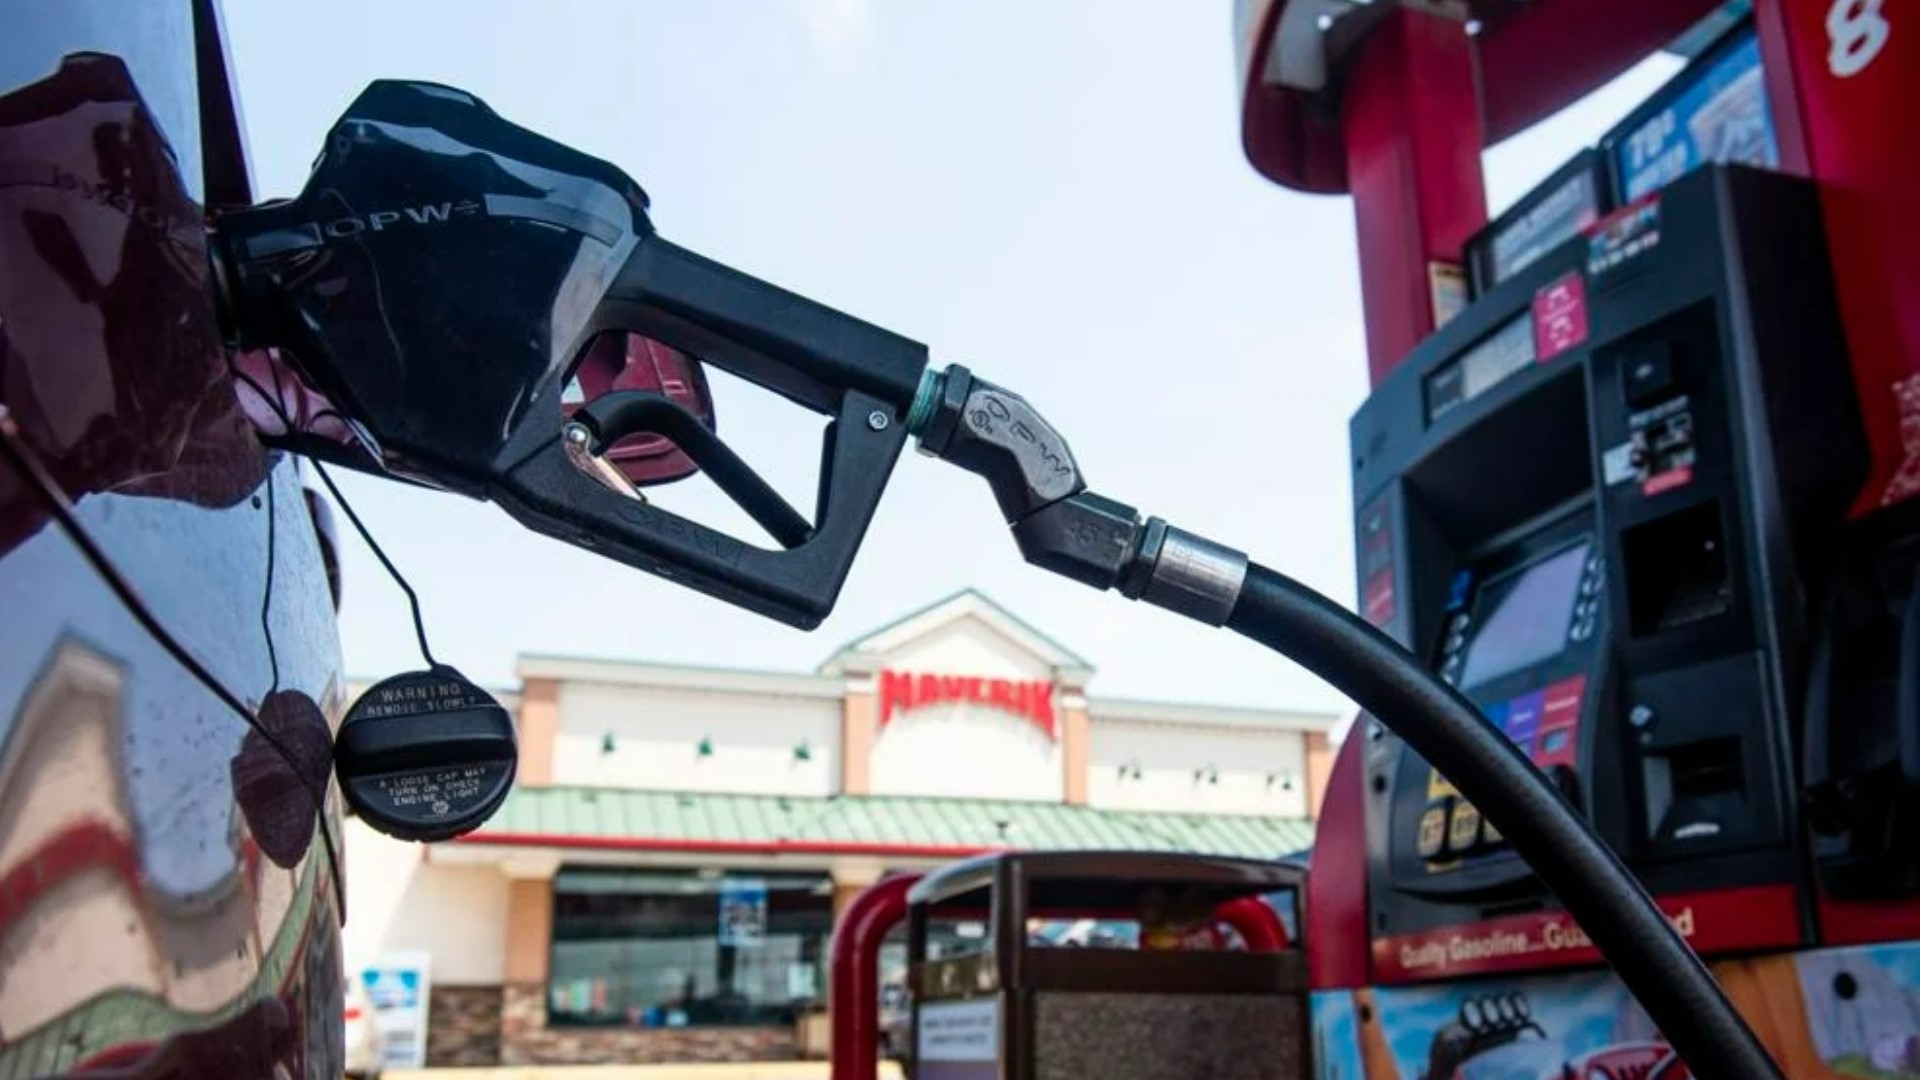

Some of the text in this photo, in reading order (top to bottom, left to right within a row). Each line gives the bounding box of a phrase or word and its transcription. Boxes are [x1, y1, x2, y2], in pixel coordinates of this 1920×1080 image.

[1824, 0, 1890, 78] 8
[325, 202, 453, 237] OPW
[984, 394, 1071, 476] OPW
[381, 683, 461, 702] WARNING
[367, 702, 418, 716] REMOVE
[879, 669, 1057, 744] MAVERIK
[394, 775, 429, 787] LOOSE
[465, 767, 486, 777] MAY
[389, 778, 480, 797] TURN ON CHECK
[393, 787, 479, 806] ENGINE LIGHT
